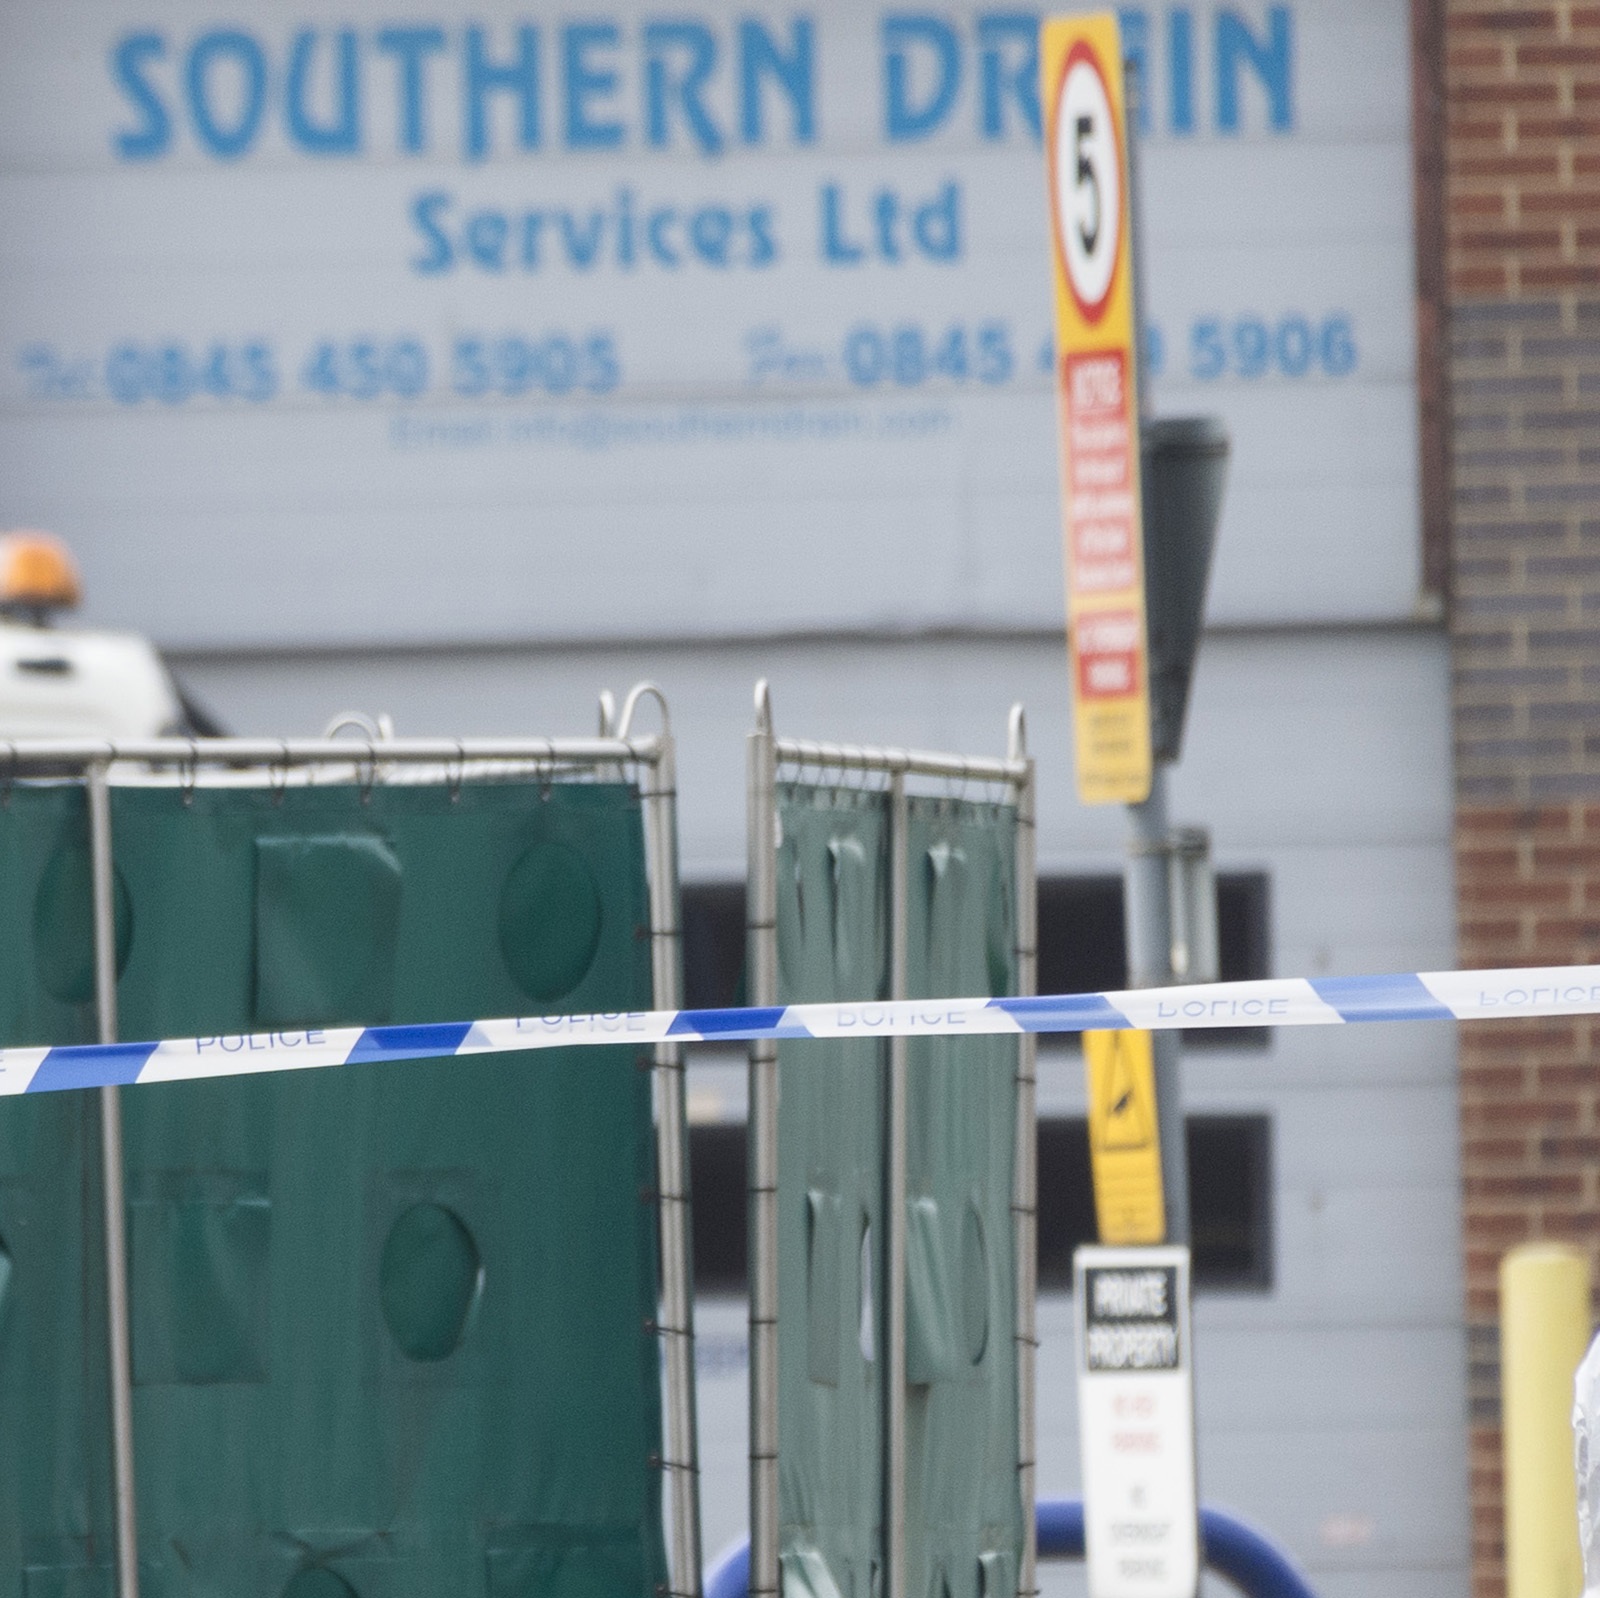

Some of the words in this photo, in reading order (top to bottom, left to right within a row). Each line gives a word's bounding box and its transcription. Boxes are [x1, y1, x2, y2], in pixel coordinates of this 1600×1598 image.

[112, 16, 818, 164] SOUTHERN
[406, 182, 778, 278] Services
[818, 178, 964, 268] Ltd
[1076, 114, 1101, 257] 5
[104, 336, 280, 406] 0845
[302, 334, 430, 402] 450
[452, 325, 620, 400] 5905
[842, 318, 1014, 388] 0845
[1190, 308, 1358, 380] 5906
[196, 1029, 326, 1055] POLICE
